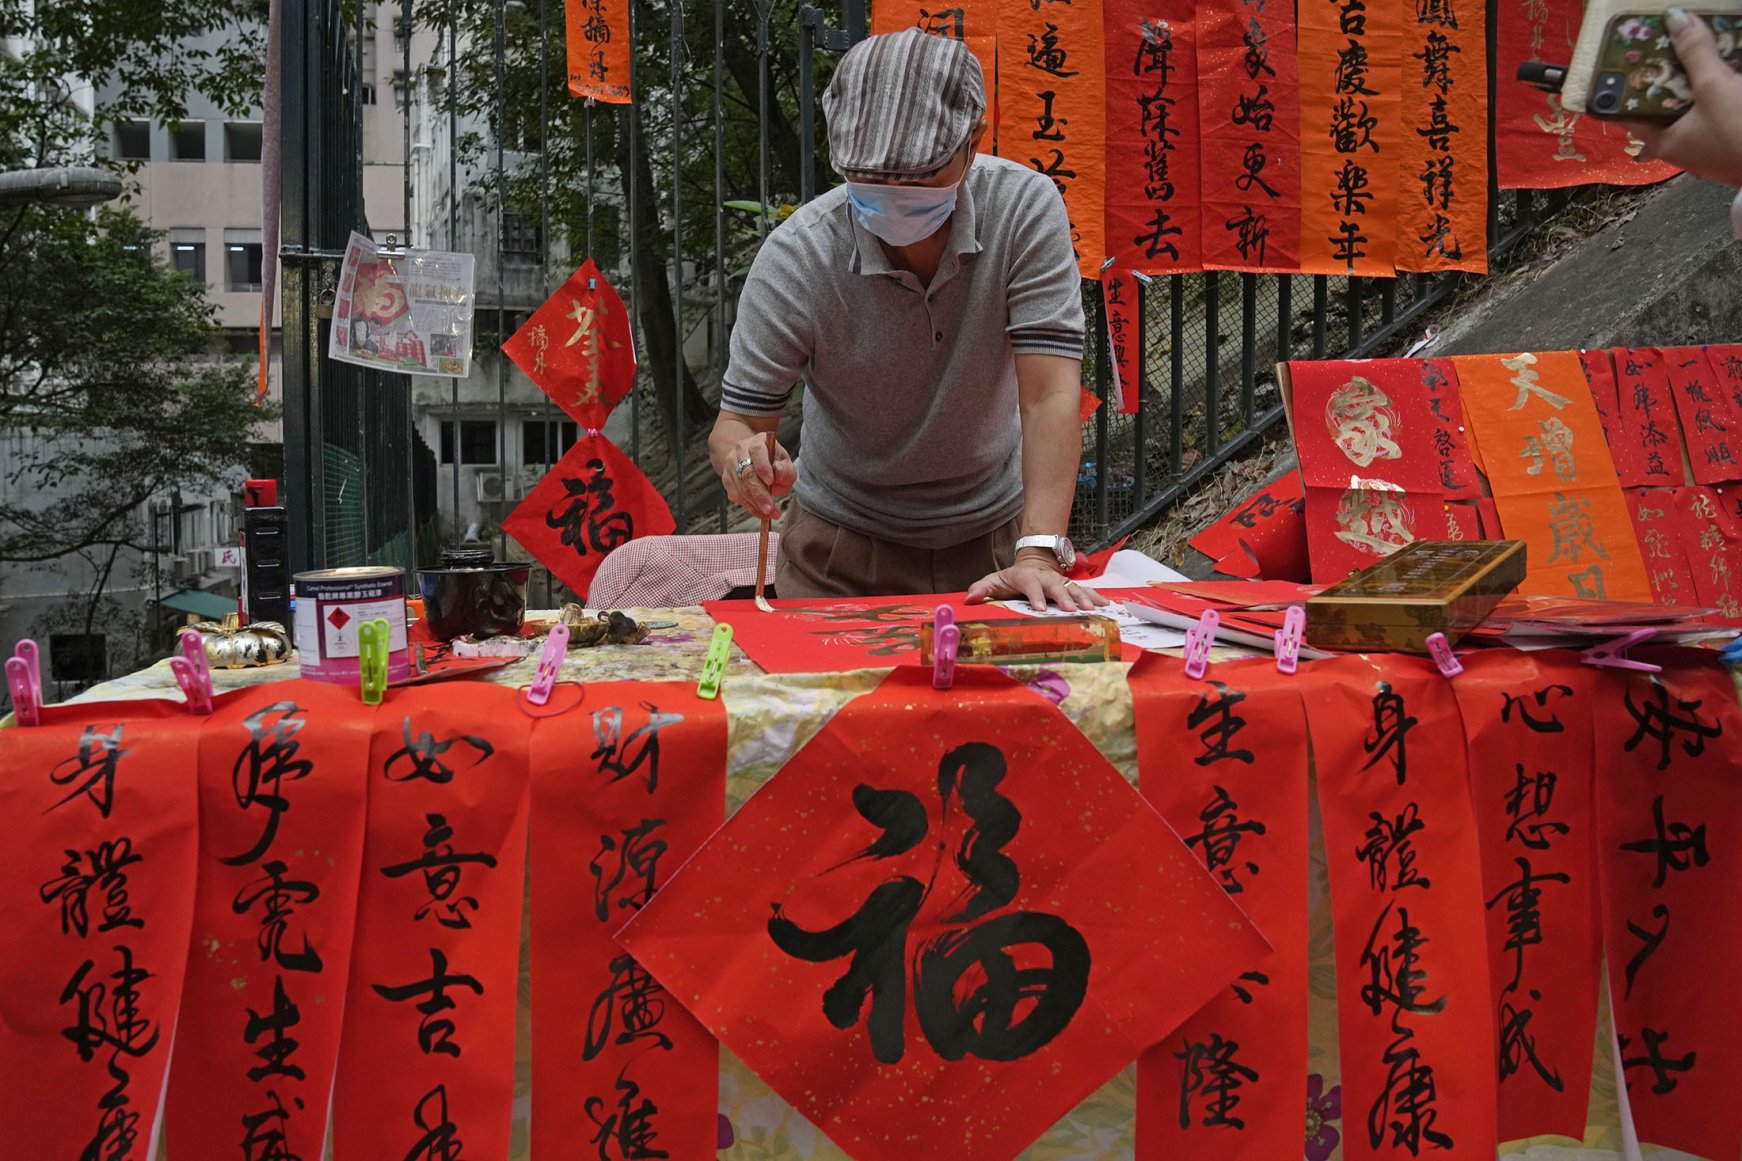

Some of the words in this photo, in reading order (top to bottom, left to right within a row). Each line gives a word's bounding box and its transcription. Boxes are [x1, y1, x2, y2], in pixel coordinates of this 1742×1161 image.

[1225, 0, 1281, 267] 象始更新
[1107, 279, 1130, 387] 生意興
[545, 458, 634, 557] 福
[767, 741, 1091, 1065] 福
[1173, 680, 1270, 1130] 生意隆
[1355, 680, 1454, 1158] 身體健康
[1486, 684, 1573, 1092] 心想事成
